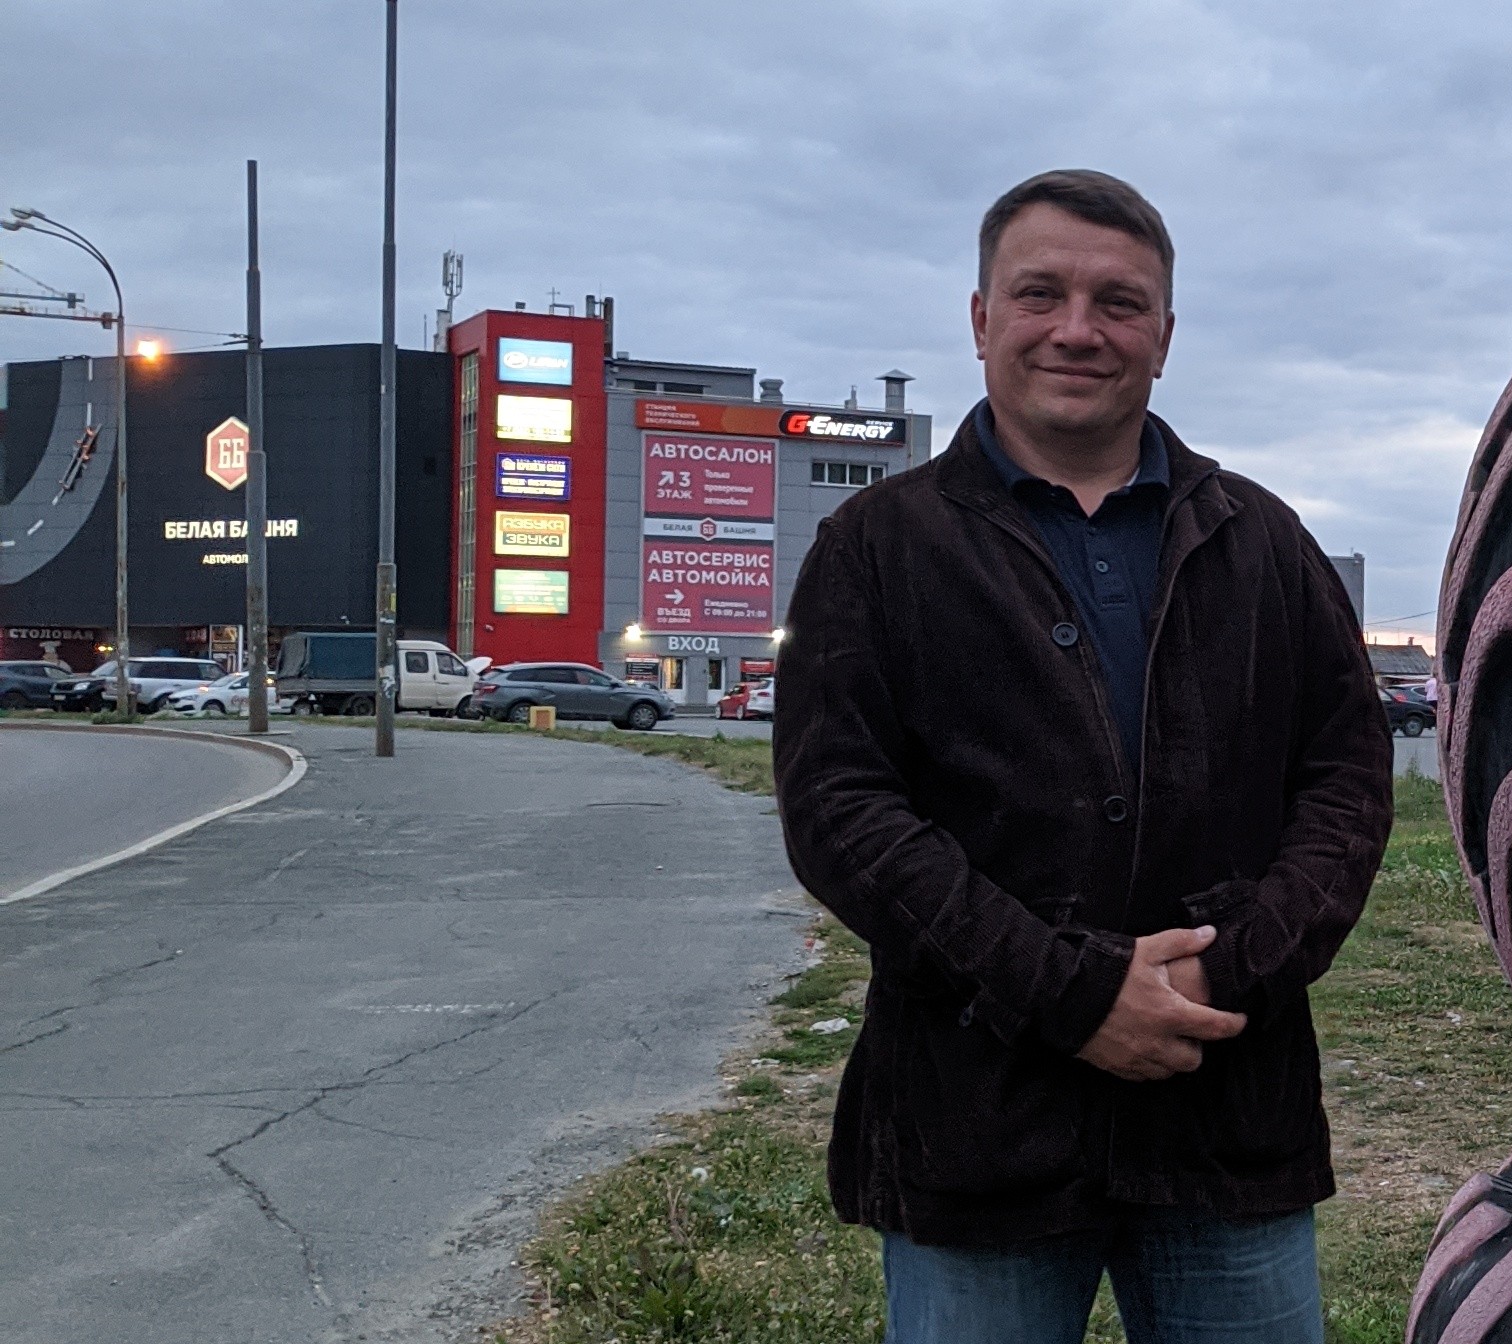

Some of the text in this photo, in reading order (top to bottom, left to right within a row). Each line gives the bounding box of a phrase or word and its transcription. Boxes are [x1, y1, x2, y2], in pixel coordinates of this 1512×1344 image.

[650, 442, 772, 464] АВТОСАЛОН
[679, 471, 691, 487] 3
[657, 488, 692, 499] ЭТАЖ
[165, 520, 225, 540] БЕЛАЯ
[663, 523, 693, 531] БЕЛАЯ
[723, 526, 756, 534] БАШНЯ
[505, 533, 560, 546] ЗВУКА
[202, 554, 248, 565] АВТОМОЛ
[648, 550, 770, 568] АВТОСЕРВИС
[647, 567, 770, 587] АВТОМОЙКА
[657, 607, 691, 617] ВЪЕЗД
[9, 628, 94, 640] СТОЛОВАЯ
[668, 636, 720, 654] ВХОД
